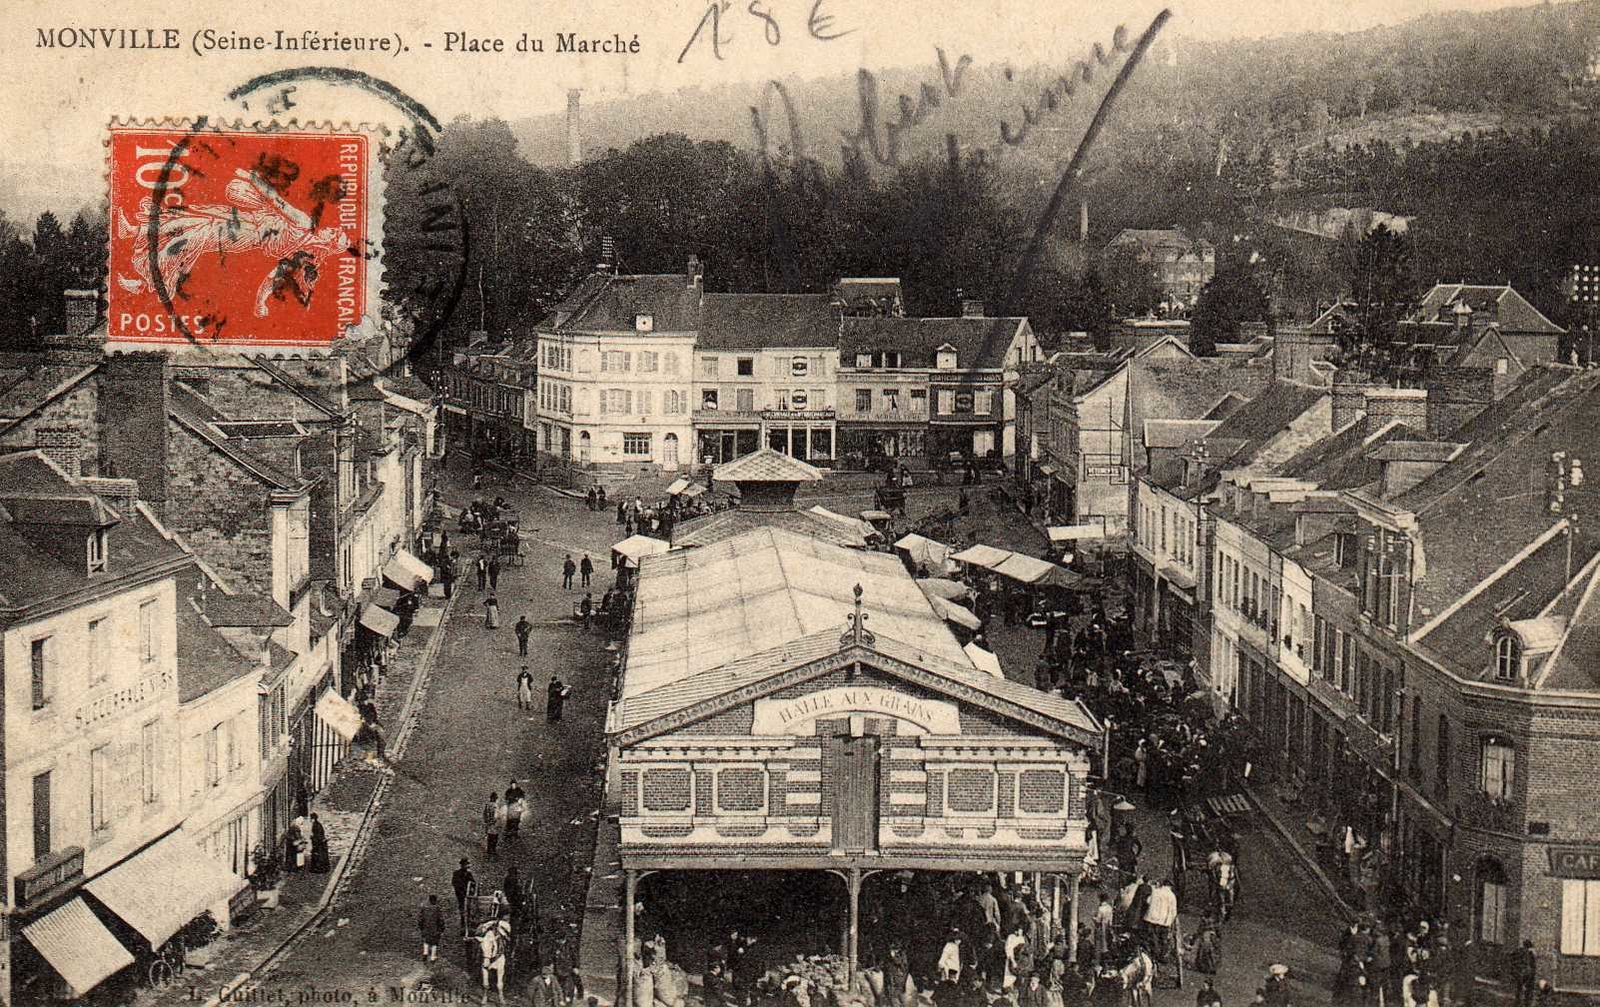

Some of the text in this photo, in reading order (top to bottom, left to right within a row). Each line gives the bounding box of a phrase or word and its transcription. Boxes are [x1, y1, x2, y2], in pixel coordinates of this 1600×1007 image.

[120, 313, 206, 335] POSTES
[779, 691, 935, 723] HALLE AUX GRAINS
